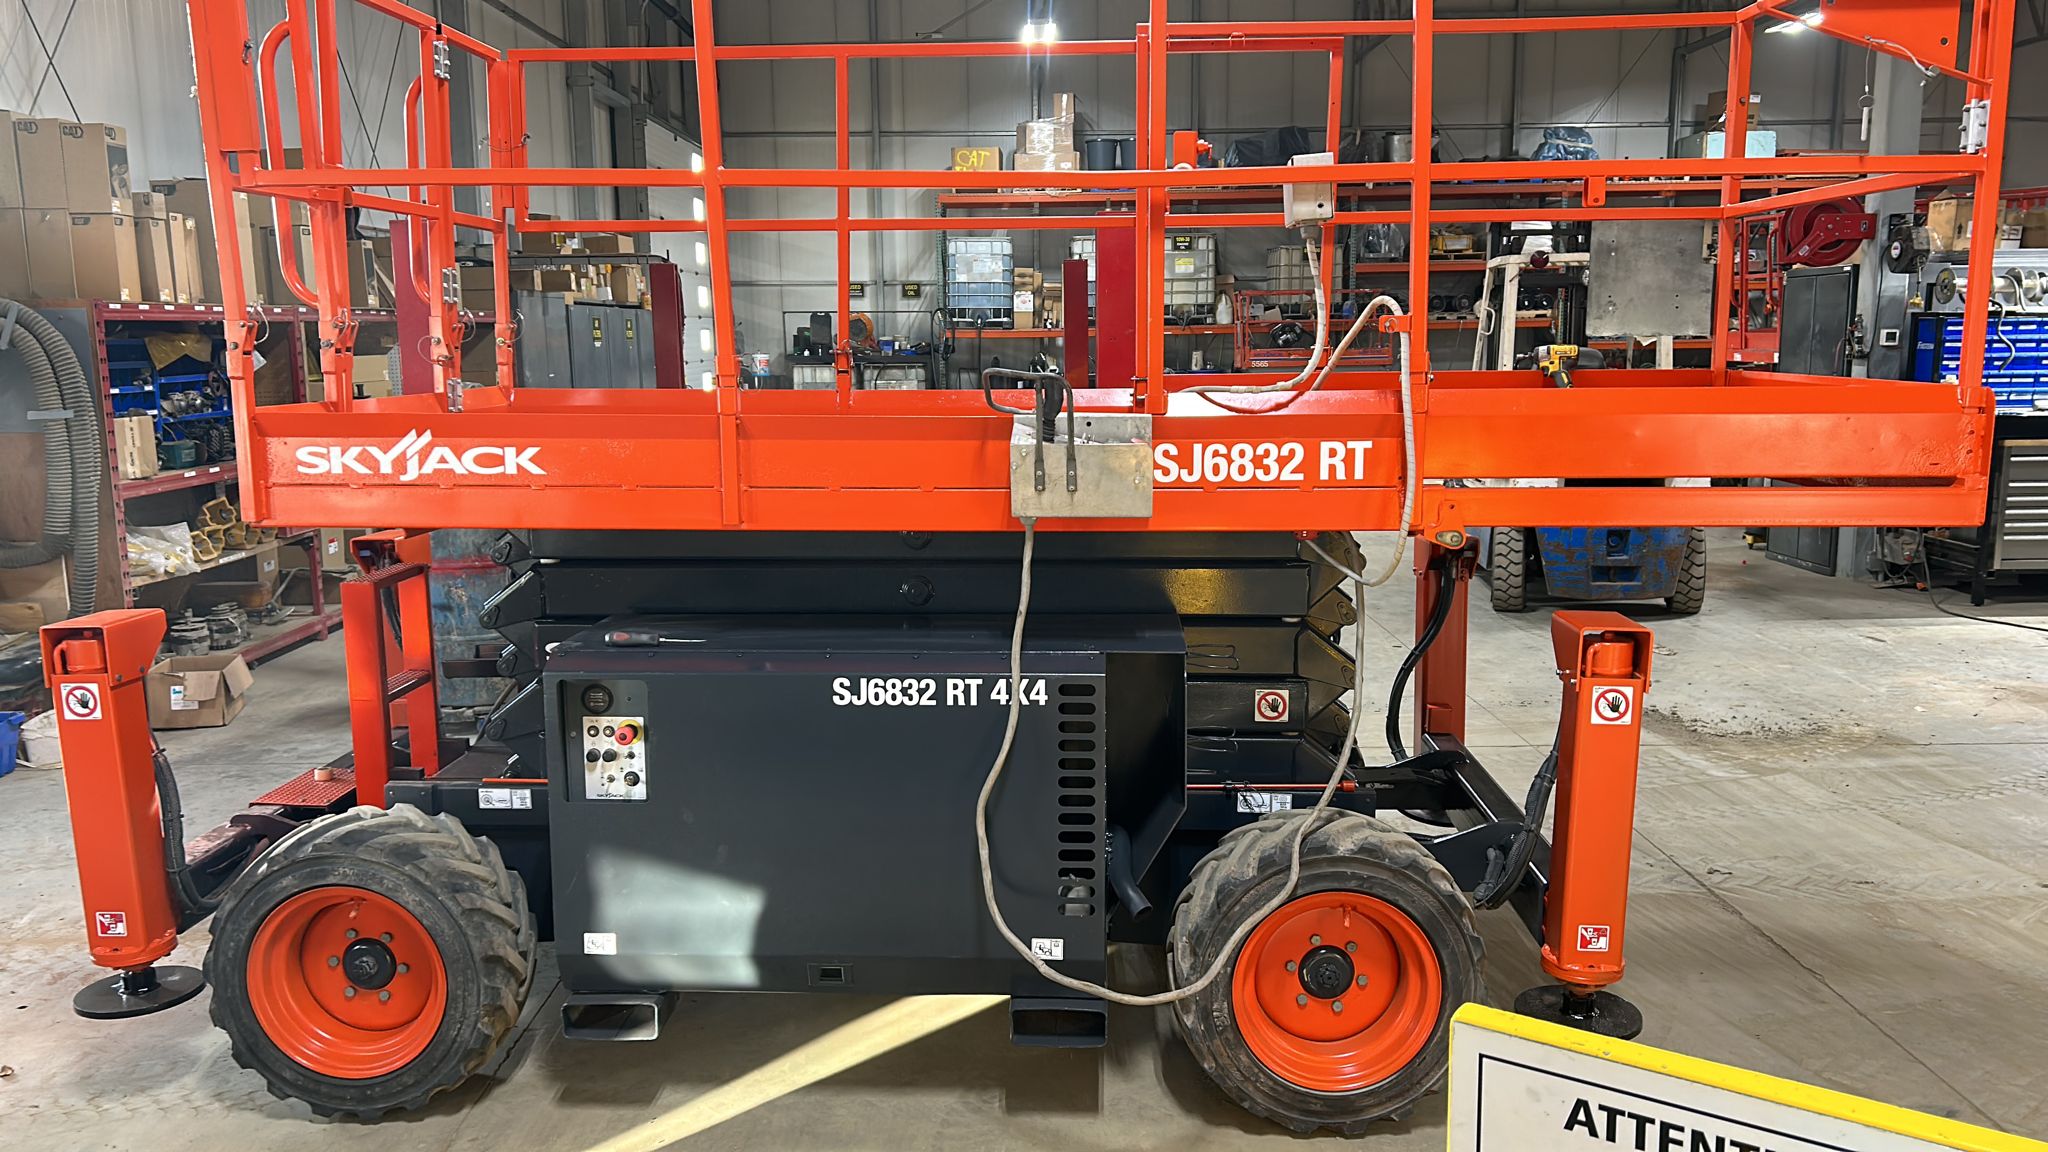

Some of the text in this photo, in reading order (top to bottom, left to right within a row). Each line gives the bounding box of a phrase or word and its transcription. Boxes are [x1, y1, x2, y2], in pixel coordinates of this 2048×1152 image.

[957, 150, 990, 168] CAT
[295, 428, 547, 481] SKYJACK
[1153, 440, 1373, 483] SJ6832 RT
[832, 677, 937, 706] SJ6832
[946, 678, 983, 706] RT
[1563, 1097, 1777, 1152] ATTEN
